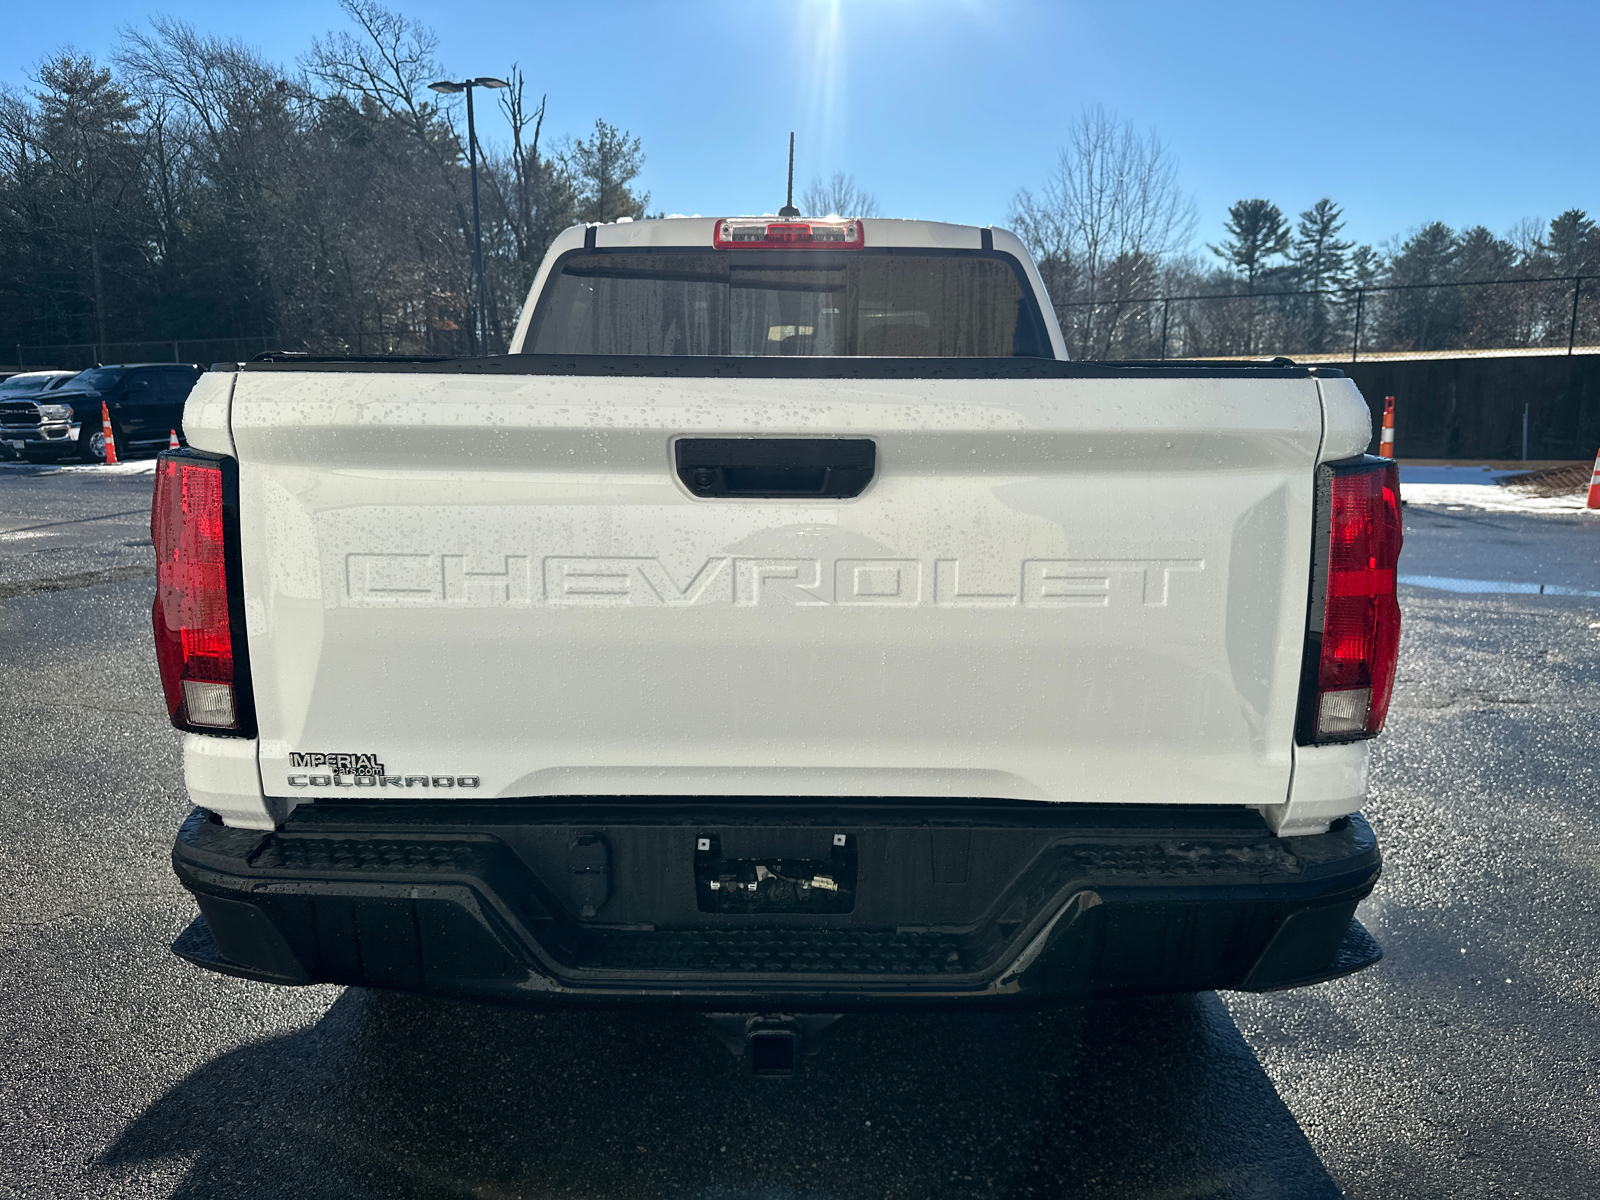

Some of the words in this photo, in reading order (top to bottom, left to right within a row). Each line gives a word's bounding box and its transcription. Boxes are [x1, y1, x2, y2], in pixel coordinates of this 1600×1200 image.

[345, 552, 1206, 608] CHEVROLET
[288, 752, 384, 769] IMPERIAL
[332, 766, 384, 776] cars.com
[287, 773, 480, 789] COLORADO
